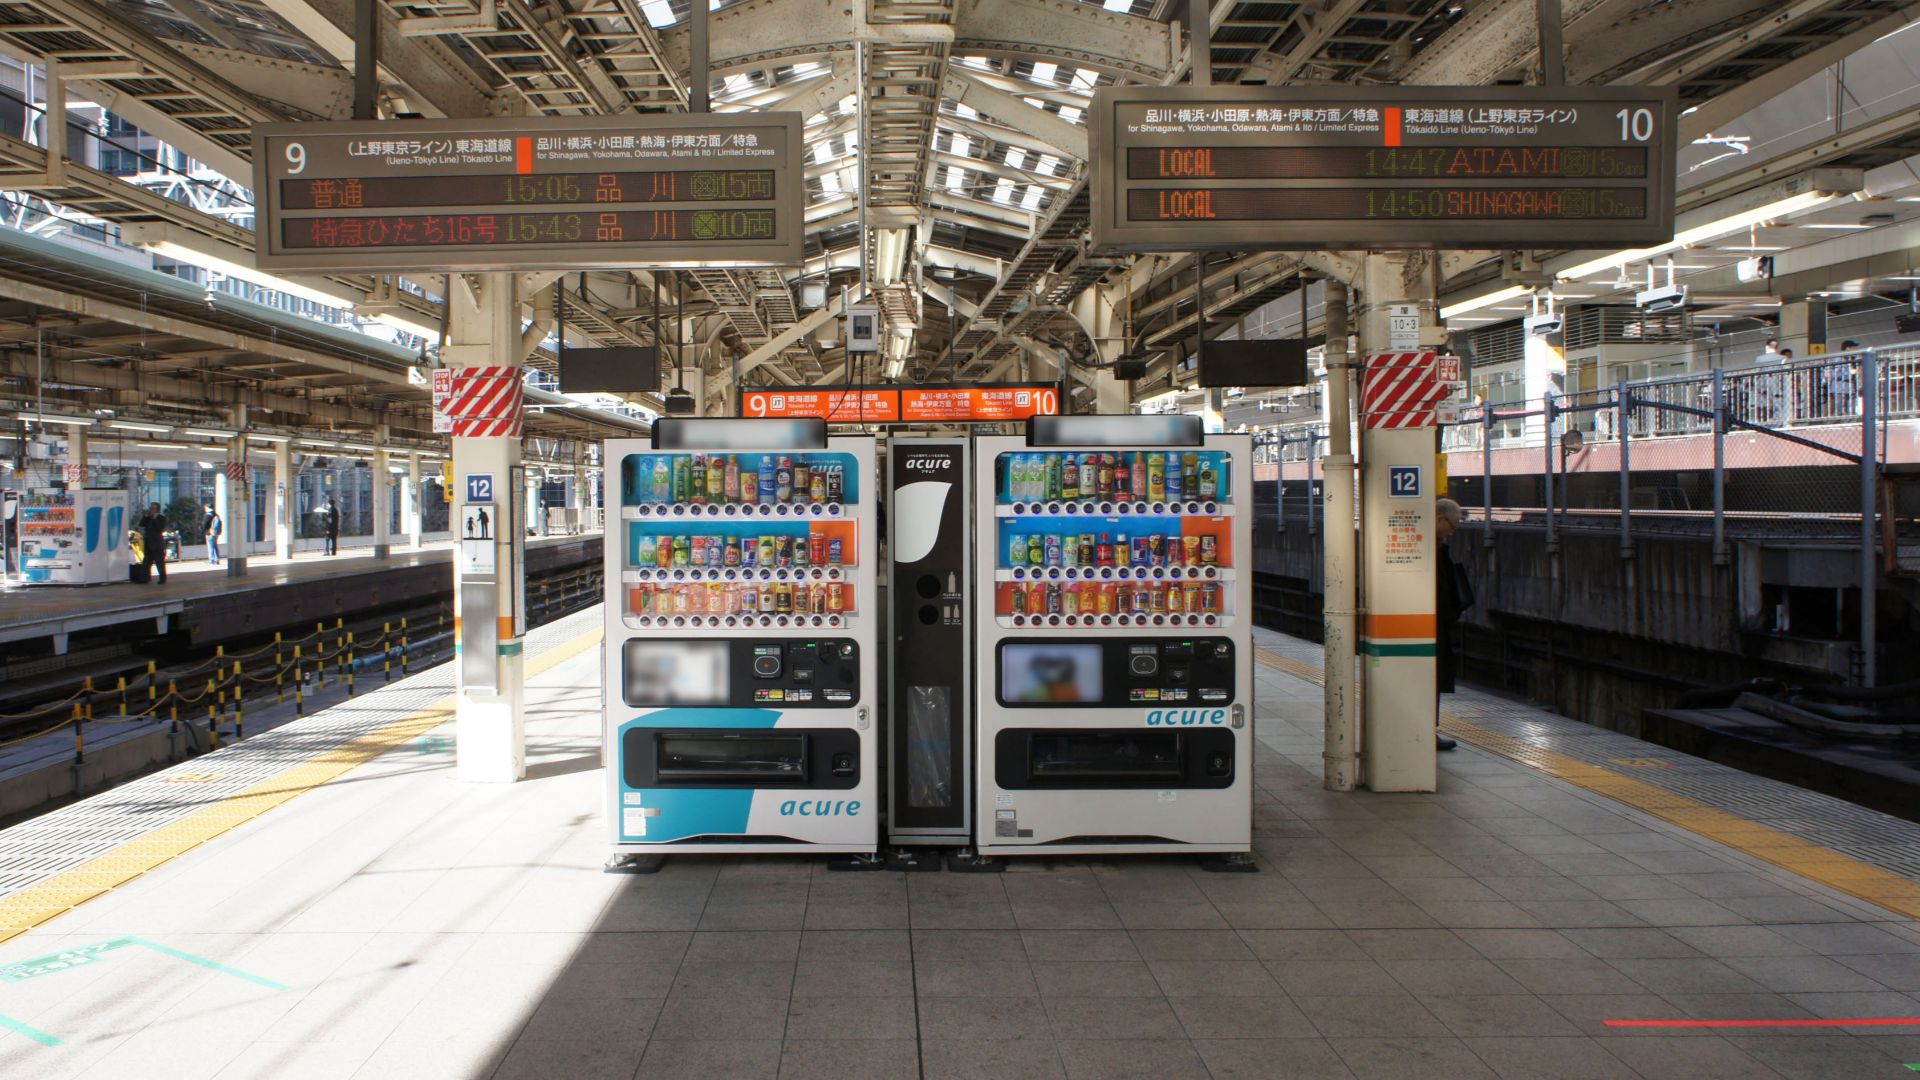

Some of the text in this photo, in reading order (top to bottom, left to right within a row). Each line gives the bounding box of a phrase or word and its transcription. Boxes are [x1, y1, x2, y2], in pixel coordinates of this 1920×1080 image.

[1128, 124, 1139, 132] for
[1140, 124, 1184, 134] Shinagawa,
[1187, 124, 1229, 132] Yokohama,
[1232, 124, 1269, 133] Odawara,
[1271, 124, 1293, 132] Atami
[1319, 123, 1347, 131] Limited
[1349, 124, 1379, 133] Express
[1440, 125, 1459, 134] Line
[1517, 125, 1538, 135] Line)
[1616, 108, 1653, 141] 10
[285, 142, 306, 174] 9
[439, 154, 460, 165] Line)
[495, 154, 512, 163] Line
[548, 151, 590, 161] Shinagawa,
[592, 151, 632, 160] Yokohama,
[635, 150, 669, 159] Odawara,
[671, 149, 693, 157] Atami
[694, 149, 700, 157] &
[717, 148, 743, 157] Limited
[745, 148, 775, 157] Express
[1159, 149, 1216, 177] LOCAL
[1366, 149, 1446, 176] 14:47
[1447, 148, 1561, 174] ATAMI
[310, 178, 363, 208] 普通
[504, 176, 581, 202] 15:05
[1159, 191, 1216, 218] LOCAL
[1366, 190, 1444, 217] 14:50
[1448, 191, 1562, 215] SHINAGAWA
[311, 215, 499, 247] 特急ひたち16号
[504, 215, 582, 242] 15:43
[750, 395, 767, 418] 9
[1033, 391, 1056, 416] 10
[906, 459, 951, 469] acure
[470, 480, 490, 497] 12
[1393, 473, 1416, 491] 12
[1147, 709, 1225, 726] acure
[780, 800, 861, 816] acure
